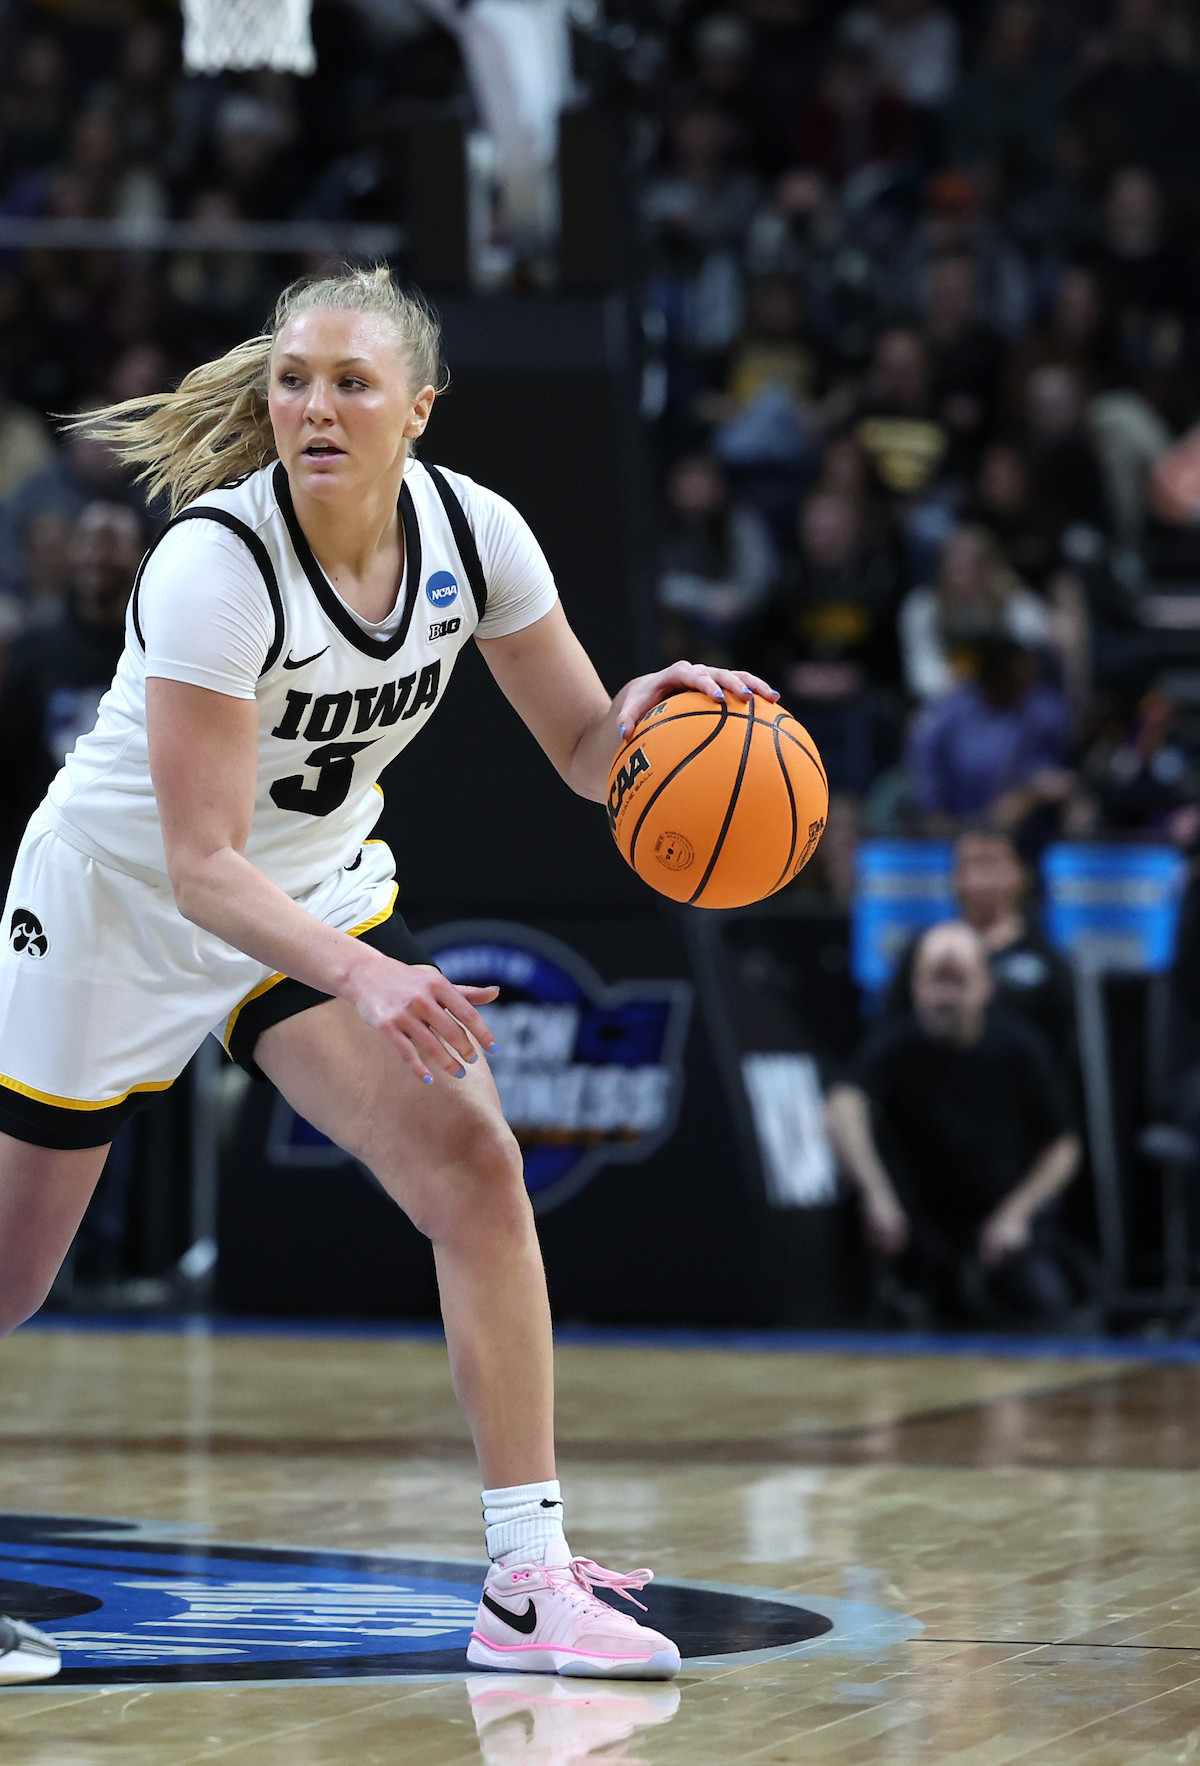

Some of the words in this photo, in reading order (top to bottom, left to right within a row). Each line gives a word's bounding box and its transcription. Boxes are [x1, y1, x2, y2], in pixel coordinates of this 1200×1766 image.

[431, 584, 458, 601] NCAA
[270, 658, 442, 741] IOWA
[269, 734, 386, 817] 3
[634, 771, 654, 792] BALL
